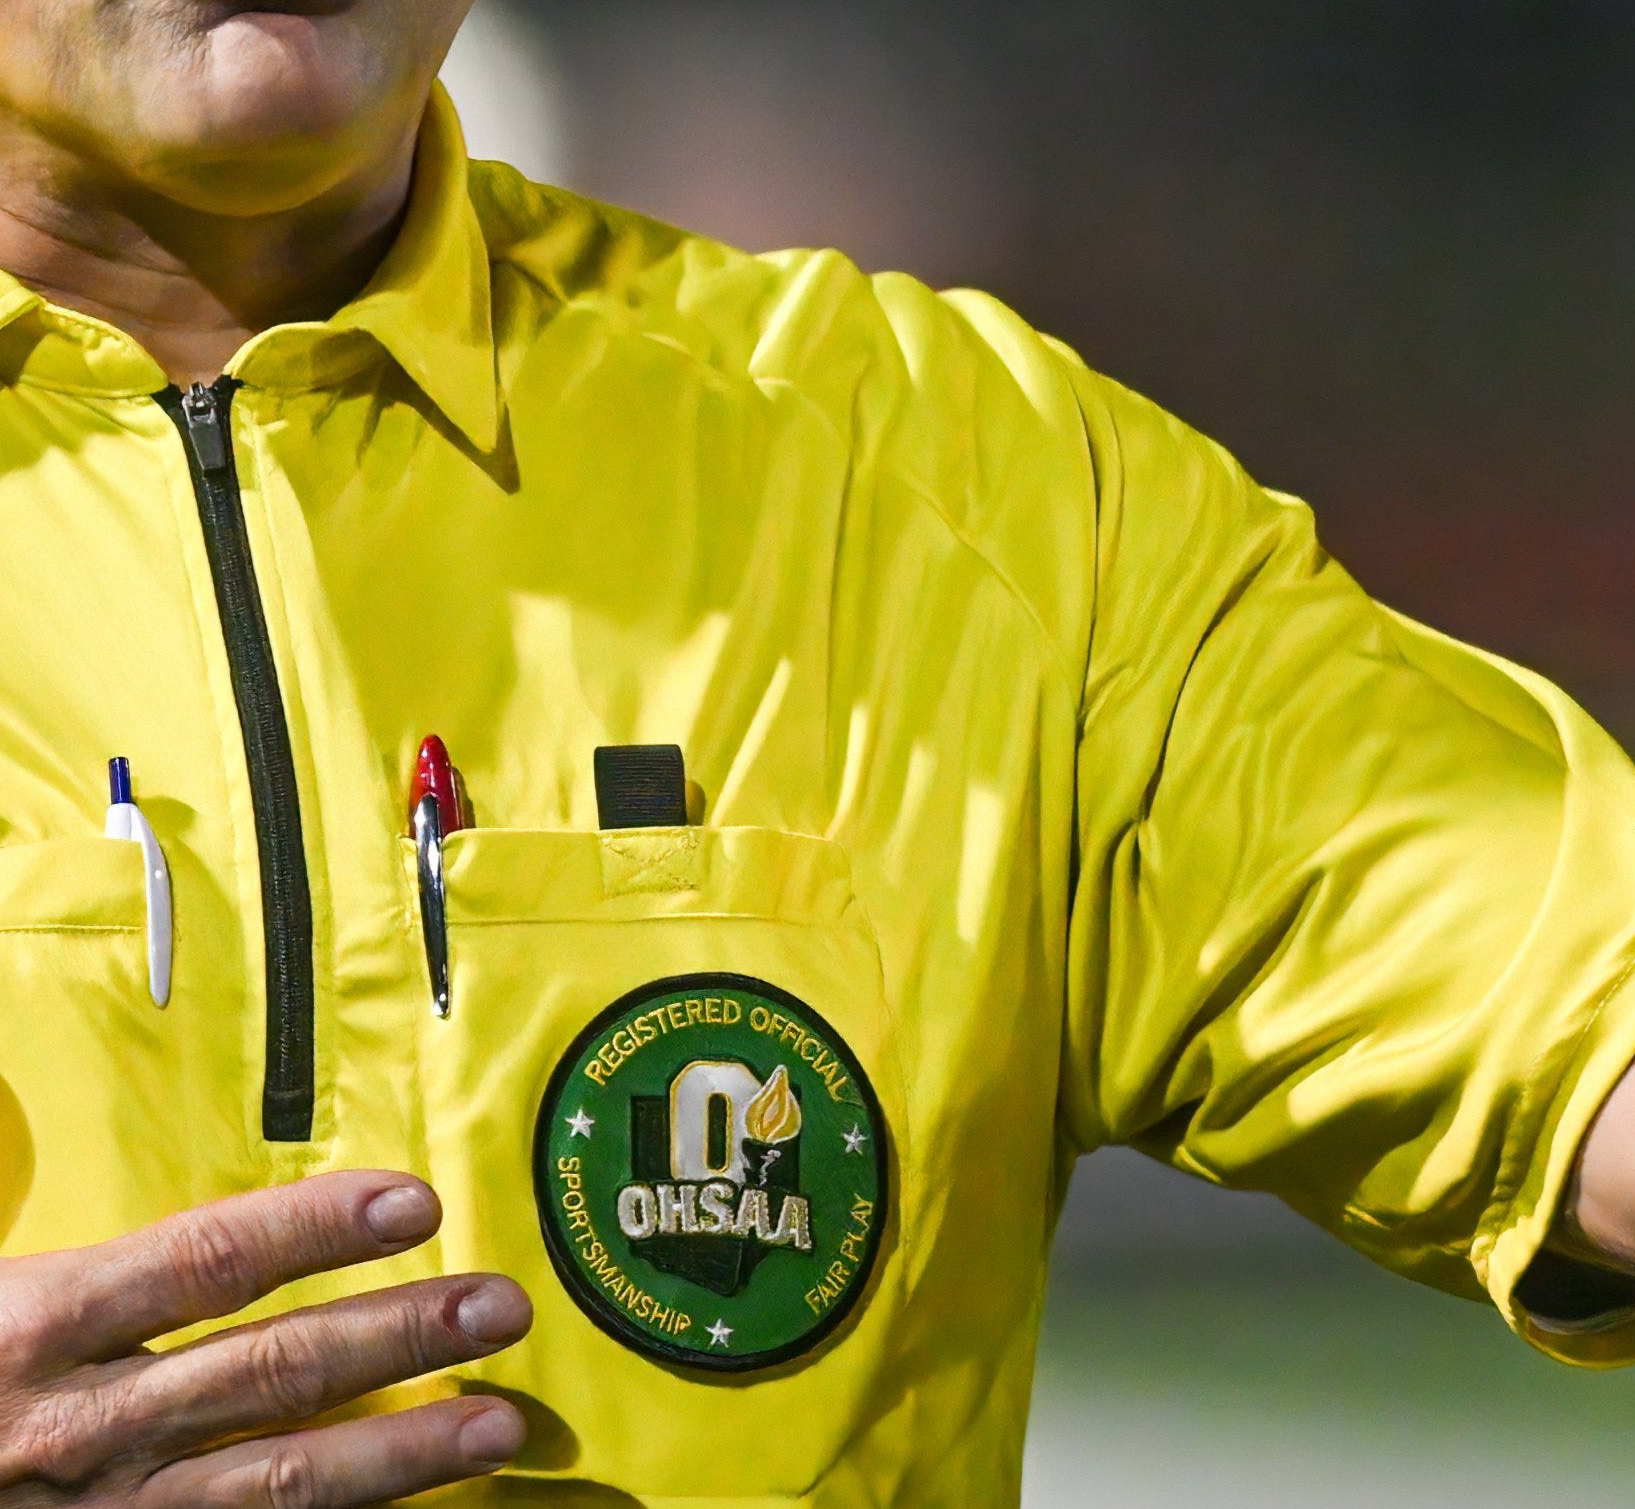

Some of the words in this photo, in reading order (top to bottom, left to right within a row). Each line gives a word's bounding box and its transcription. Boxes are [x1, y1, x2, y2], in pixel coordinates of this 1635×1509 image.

[585, 998, 743, 1086] REGISTERED
[750, 1006, 853, 1102] OFFICIAL
[557, 1156, 692, 1336] SPORTSMANSHIP
[616, 1182, 813, 1251] OHSAA
[804, 1262, 851, 1315] FAIR
[843, 1193, 874, 1261] PLAY
